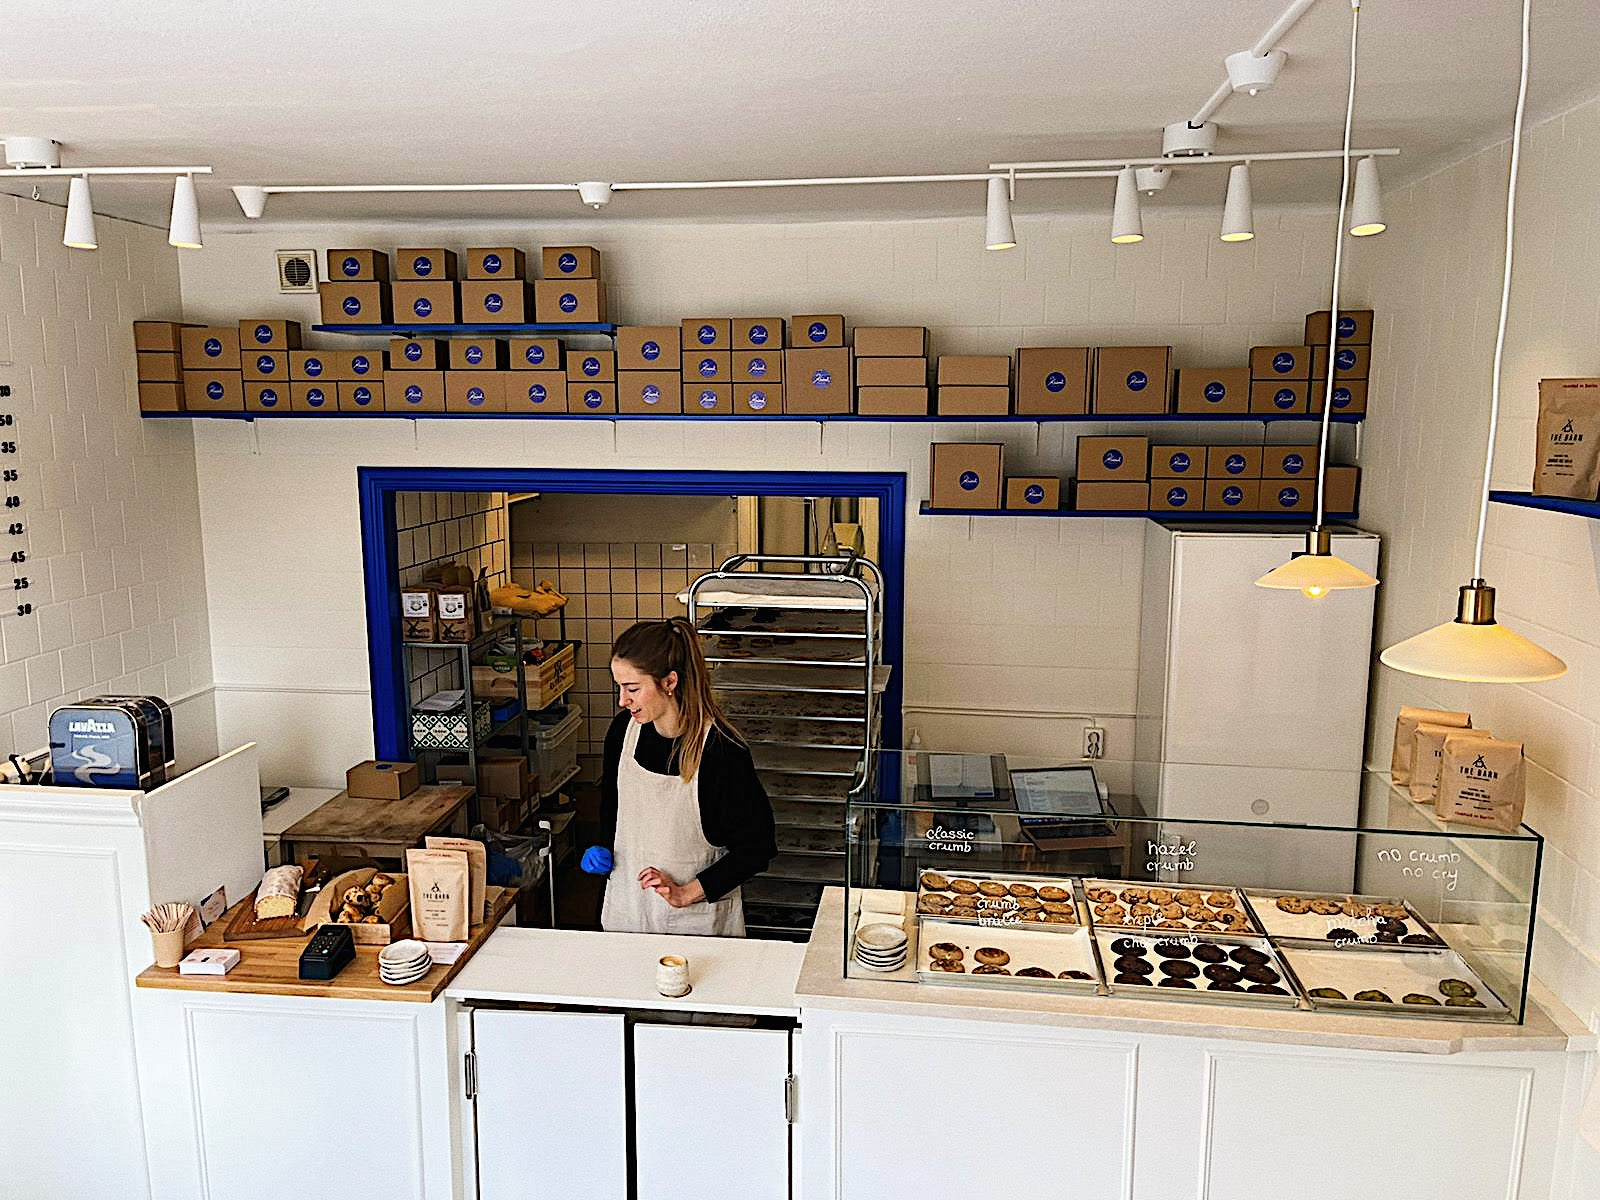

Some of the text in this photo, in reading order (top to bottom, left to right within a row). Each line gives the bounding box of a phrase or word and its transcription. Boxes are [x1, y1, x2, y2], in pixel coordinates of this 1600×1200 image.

[1, 442, 16, 453] 35
[4, 470, 18, 481] 35
[6, 496, 20, 508] 40
[9, 523, 23, 535] 42
[11, 551, 25, 563] 45
[14, 577, 29, 590] 25
[69, 718, 116, 733] LAVAZZA
[1460, 766, 1474, 775] THE
[1477, 769, 1498, 779] BARN
[926, 825, 975, 840] classic
[928, 840, 972, 853] crumb
[1147, 840, 1198, 856] hazel
[1377, 848, 1402, 862] no
[1146, 857, 1194, 871] crumb
[1402, 866, 1458, 891] no cry
[977, 897, 1020, 910] crumb
